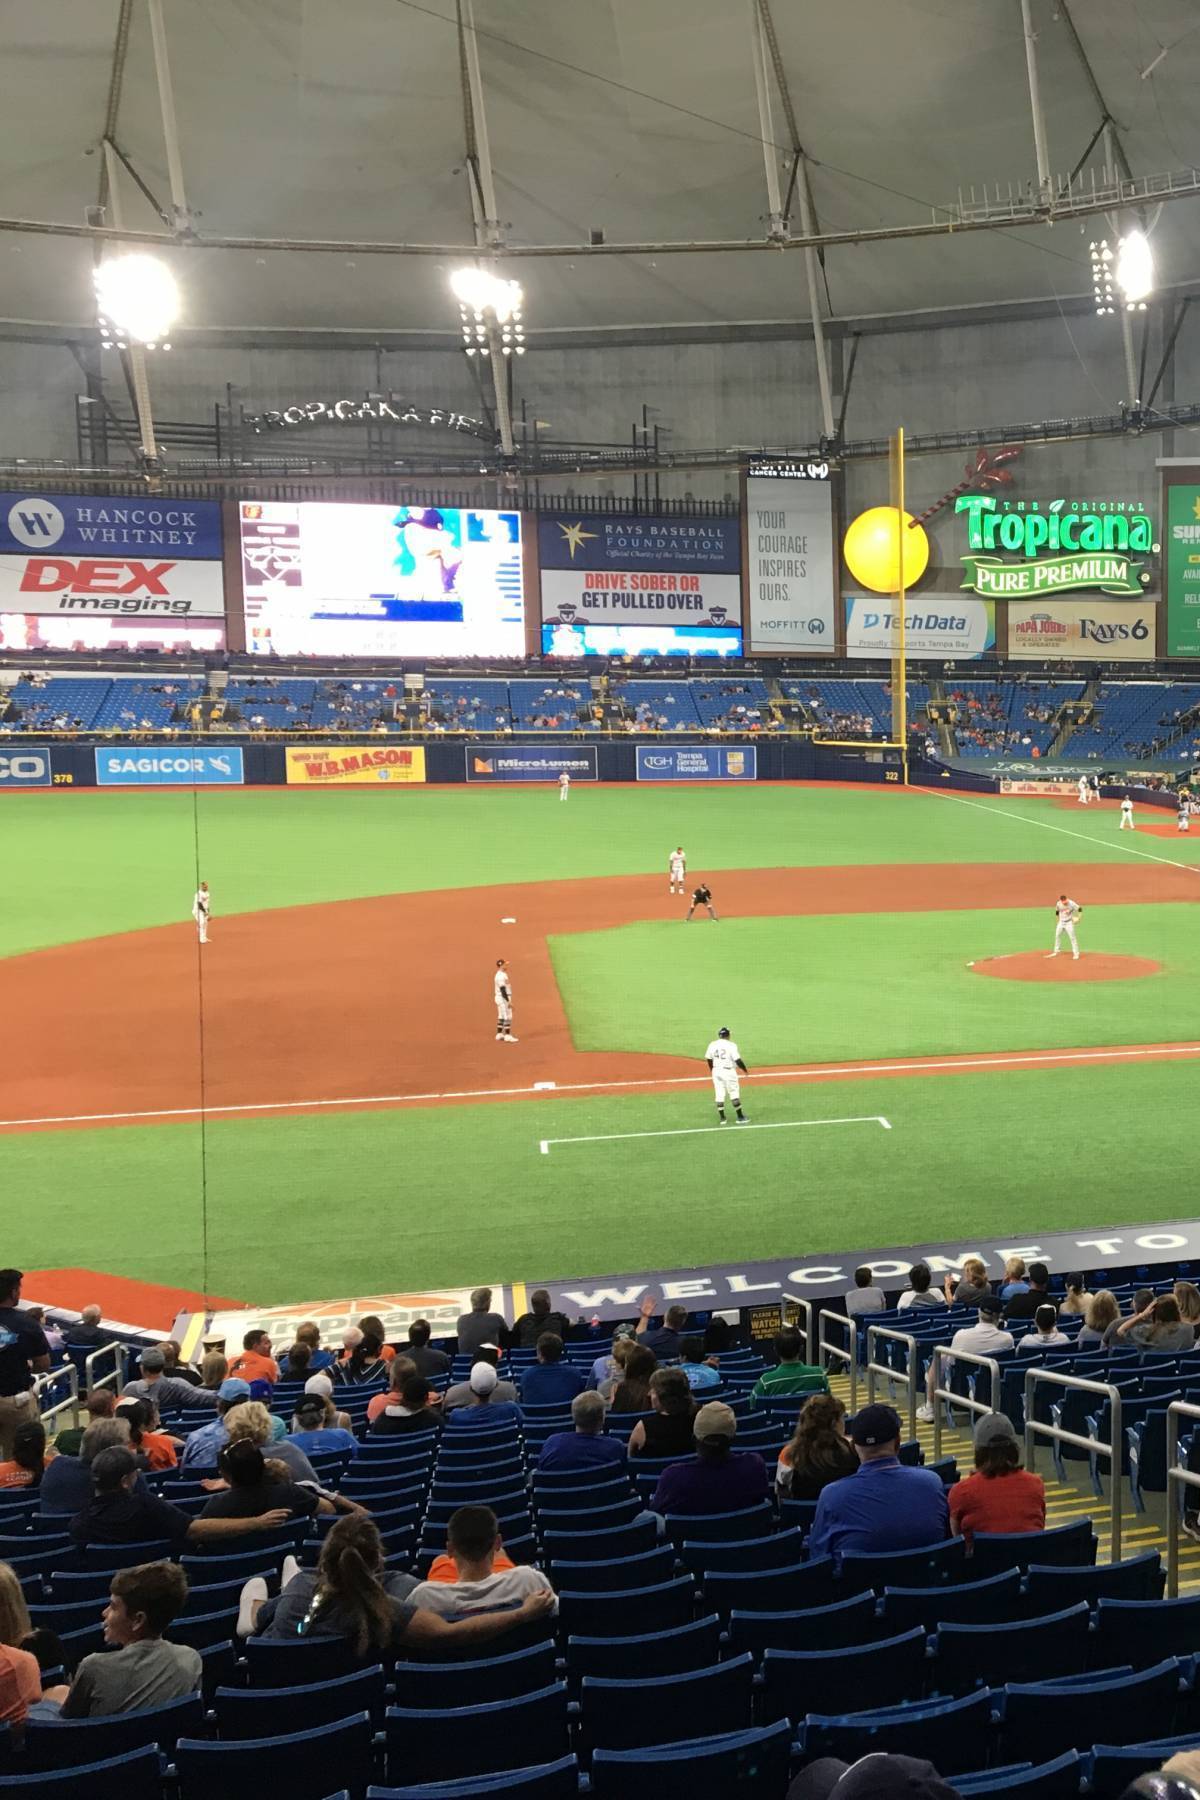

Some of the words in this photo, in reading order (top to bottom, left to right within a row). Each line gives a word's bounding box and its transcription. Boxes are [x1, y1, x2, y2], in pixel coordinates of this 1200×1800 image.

[1003, 501, 1040, 511] THE
[1071, 501, 1145, 512] ORIGINAL
[76, 507, 197, 526] HANCOCK
[756, 510, 786, 529] YOUR
[605, 525, 643, 535] RAYS
[650, 526, 725, 538] BASEBALL
[954, 495, 1153, 557] Tropicana
[78, 528, 197, 545] WHITNEY
[606, 537, 724, 550] FOUNDATION
[758, 535, 808, 554] COURAGE
[19, 558, 179, 595] DEX
[758, 560, 807, 578] INSPIRES
[976, 566, 1030, 592] PURE
[1033, 559, 1128, 589] PREMIUM
[585, 573, 628, 590] DRIVE
[630, 574, 677, 592] SOBER
[680, 576, 700, 592] OR
[759, 583, 791, 601] OURS.
[58, 594, 193, 613] imaging
[581, 592, 611, 609] GET
[612, 593, 666, 610] PULLED
[667, 594, 704, 610] OVER
[760, 620, 806, 629] MOFFITT
[883, 614, 923, 630] Tech
[924, 614, 966, 631] Data
[1015, 621, 1038, 634] PAPA
[1131, 618, 1149, 641] 6
[108, 758, 204, 774] SAGICOR
[498, 759, 590, 768] MicroLumen
[648, 756, 673, 766] TGH
[676, 752, 703, 761] Tampa
[676, 758, 707, 767] General
[676, 764, 709, 774] Hospital
[885, 771, 899, 781] 322
[54, 774, 73, 784] 378
[713, 1048, 727, 1060] 42
[559, 1245, 1053, 1309] WELCOME
[1075, 1233, 1189, 1256] TO
[751, 1318, 781, 1330] WATCH
